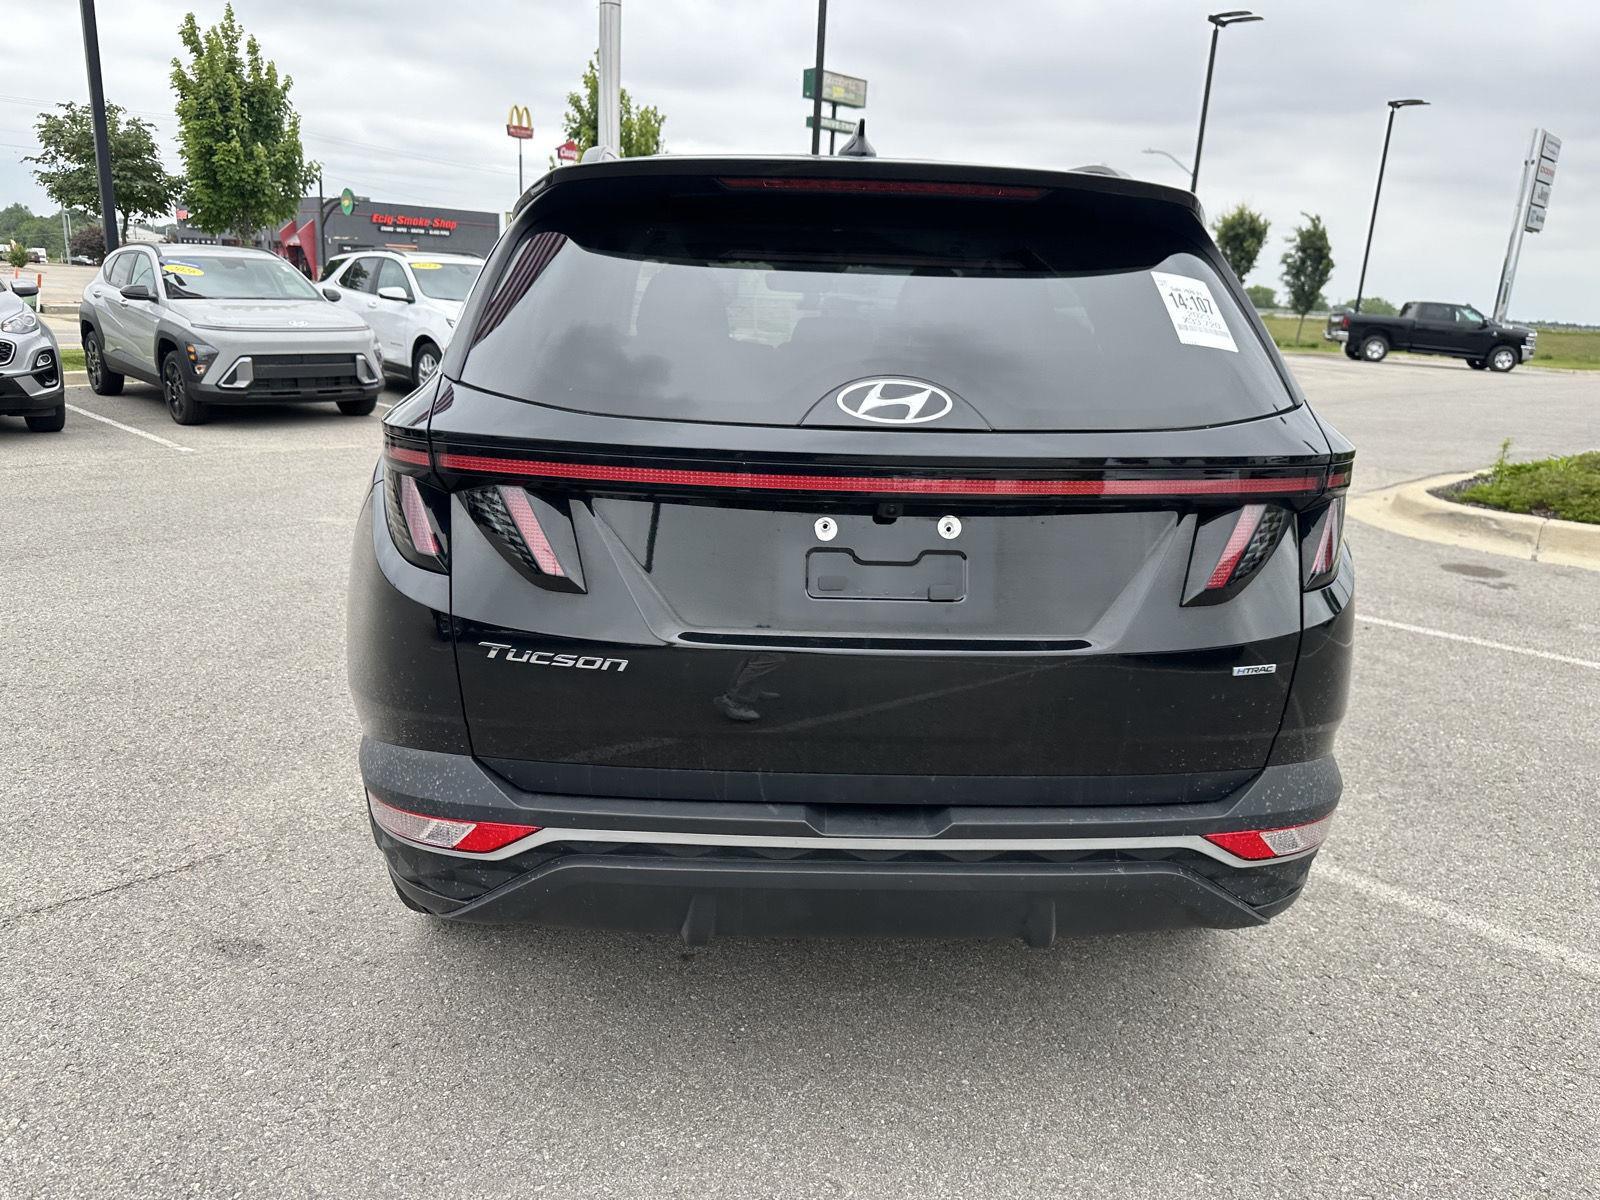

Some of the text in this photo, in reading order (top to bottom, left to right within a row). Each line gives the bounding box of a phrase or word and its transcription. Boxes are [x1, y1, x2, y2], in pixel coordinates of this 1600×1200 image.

[396, 215, 430, 227] Smoke
[432, 217, 457, 230] Shop
[1169, 291, 1214, 315] 14:107
[1236, 665, 1275, 675] HTRAC
